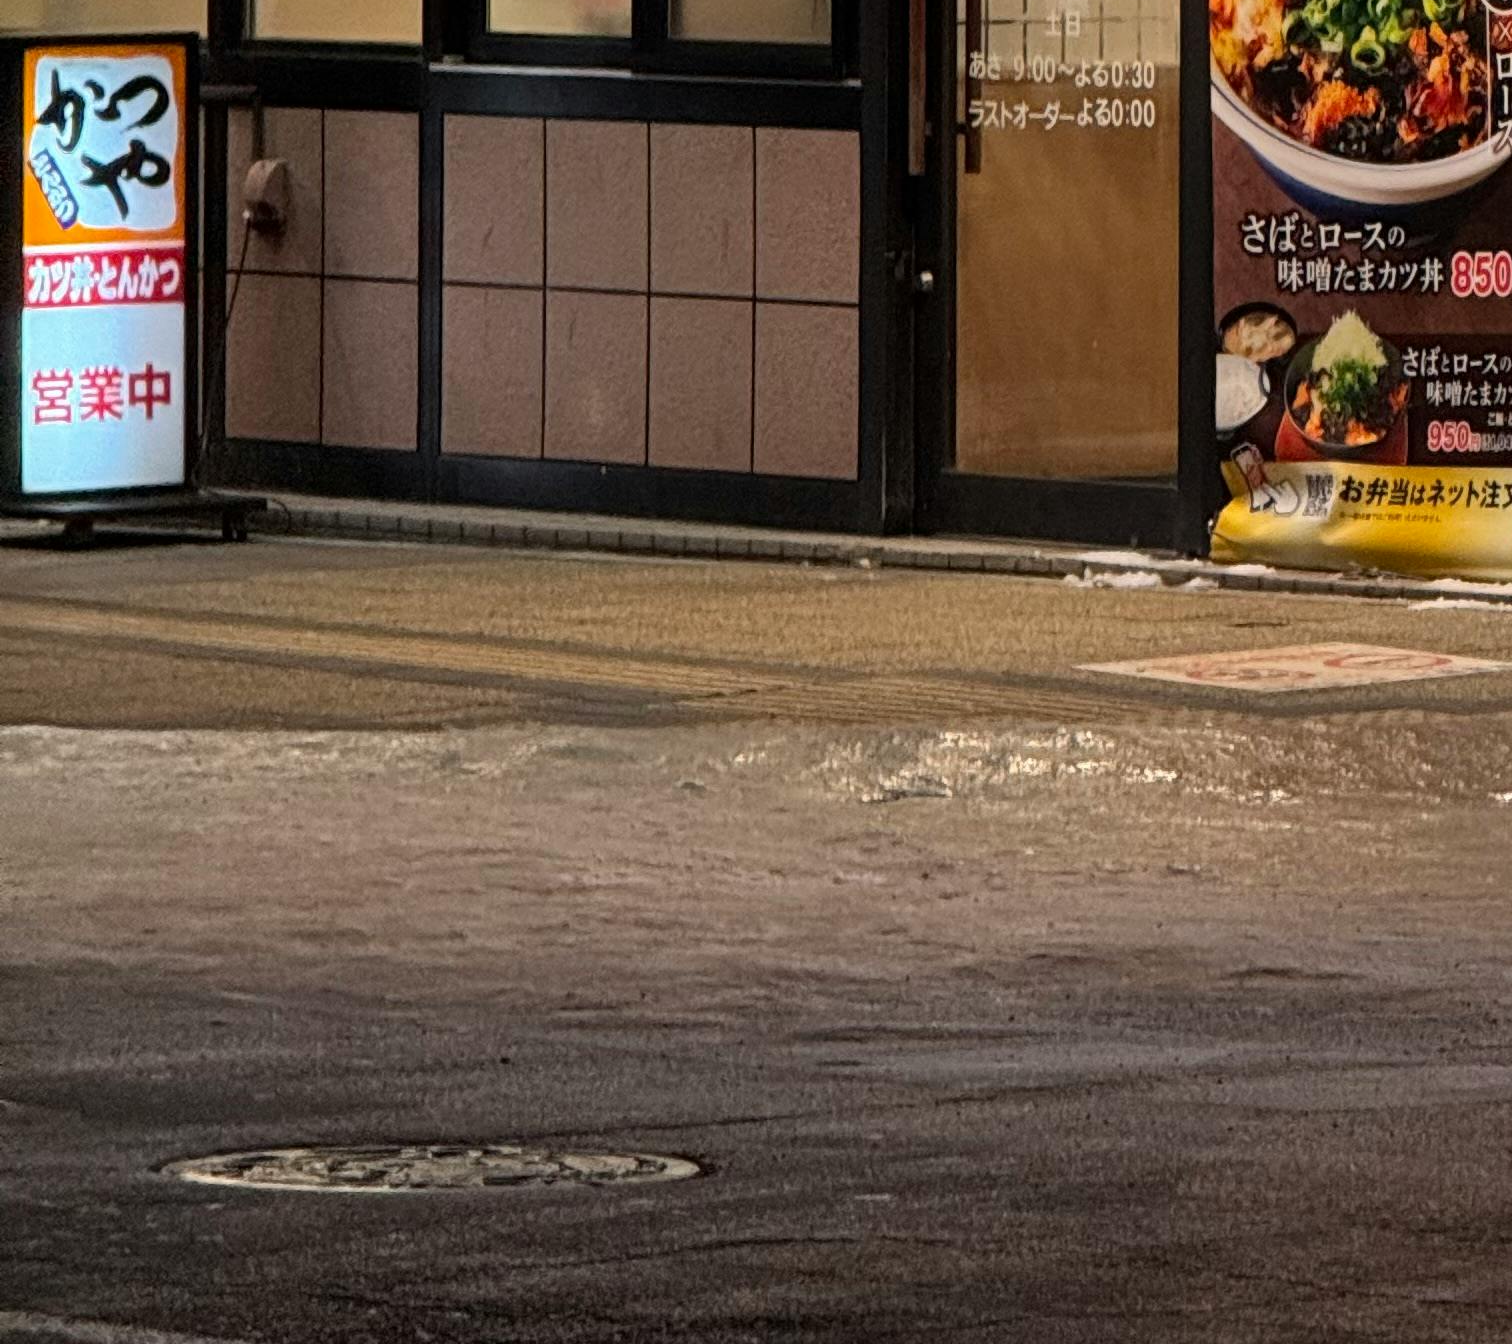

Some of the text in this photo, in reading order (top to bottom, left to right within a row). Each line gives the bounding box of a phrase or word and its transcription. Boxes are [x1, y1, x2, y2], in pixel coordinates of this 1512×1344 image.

[37, 68, 171, 222] かつや
[1242, 212, 1405, 254] さばとロースの
[1277, 256, 1444, 293] 味噌たまカツ丼
[1402, 345, 1512, 377] さばとロースの
[32, 362, 171, 426] 営業中
